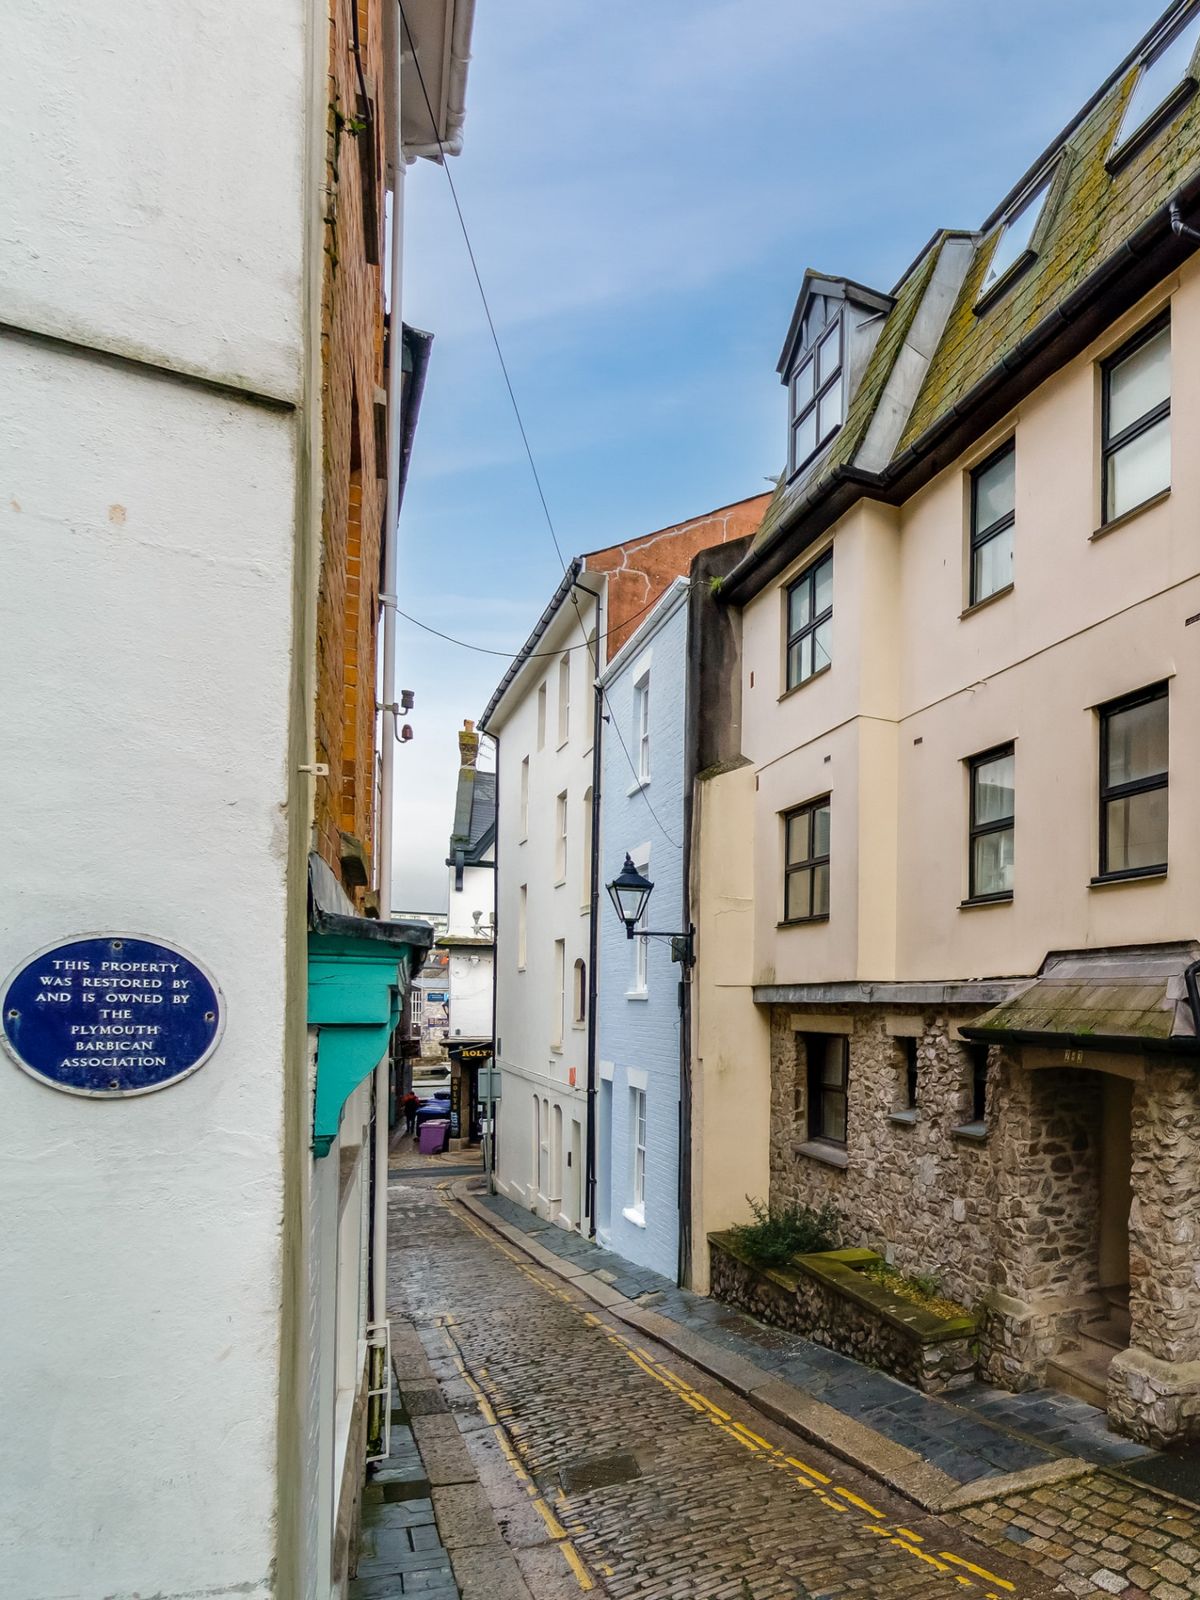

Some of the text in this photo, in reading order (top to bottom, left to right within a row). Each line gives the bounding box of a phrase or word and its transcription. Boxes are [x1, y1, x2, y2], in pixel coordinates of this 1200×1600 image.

[52, 960, 180, 973] THIS PROPERTY
[40, 977, 190, 989] WAS RESTORED BY
[35, 993, 190, 1004] AND IS OWNED BY
[100, 1009, 132, 1019] THE
[71, 1025, 159, 1036] PLYMOUTH
[76, 1041, 153, 1051] BARBICAN
[60, 1057, 167, 1067] ASSOCIATION
